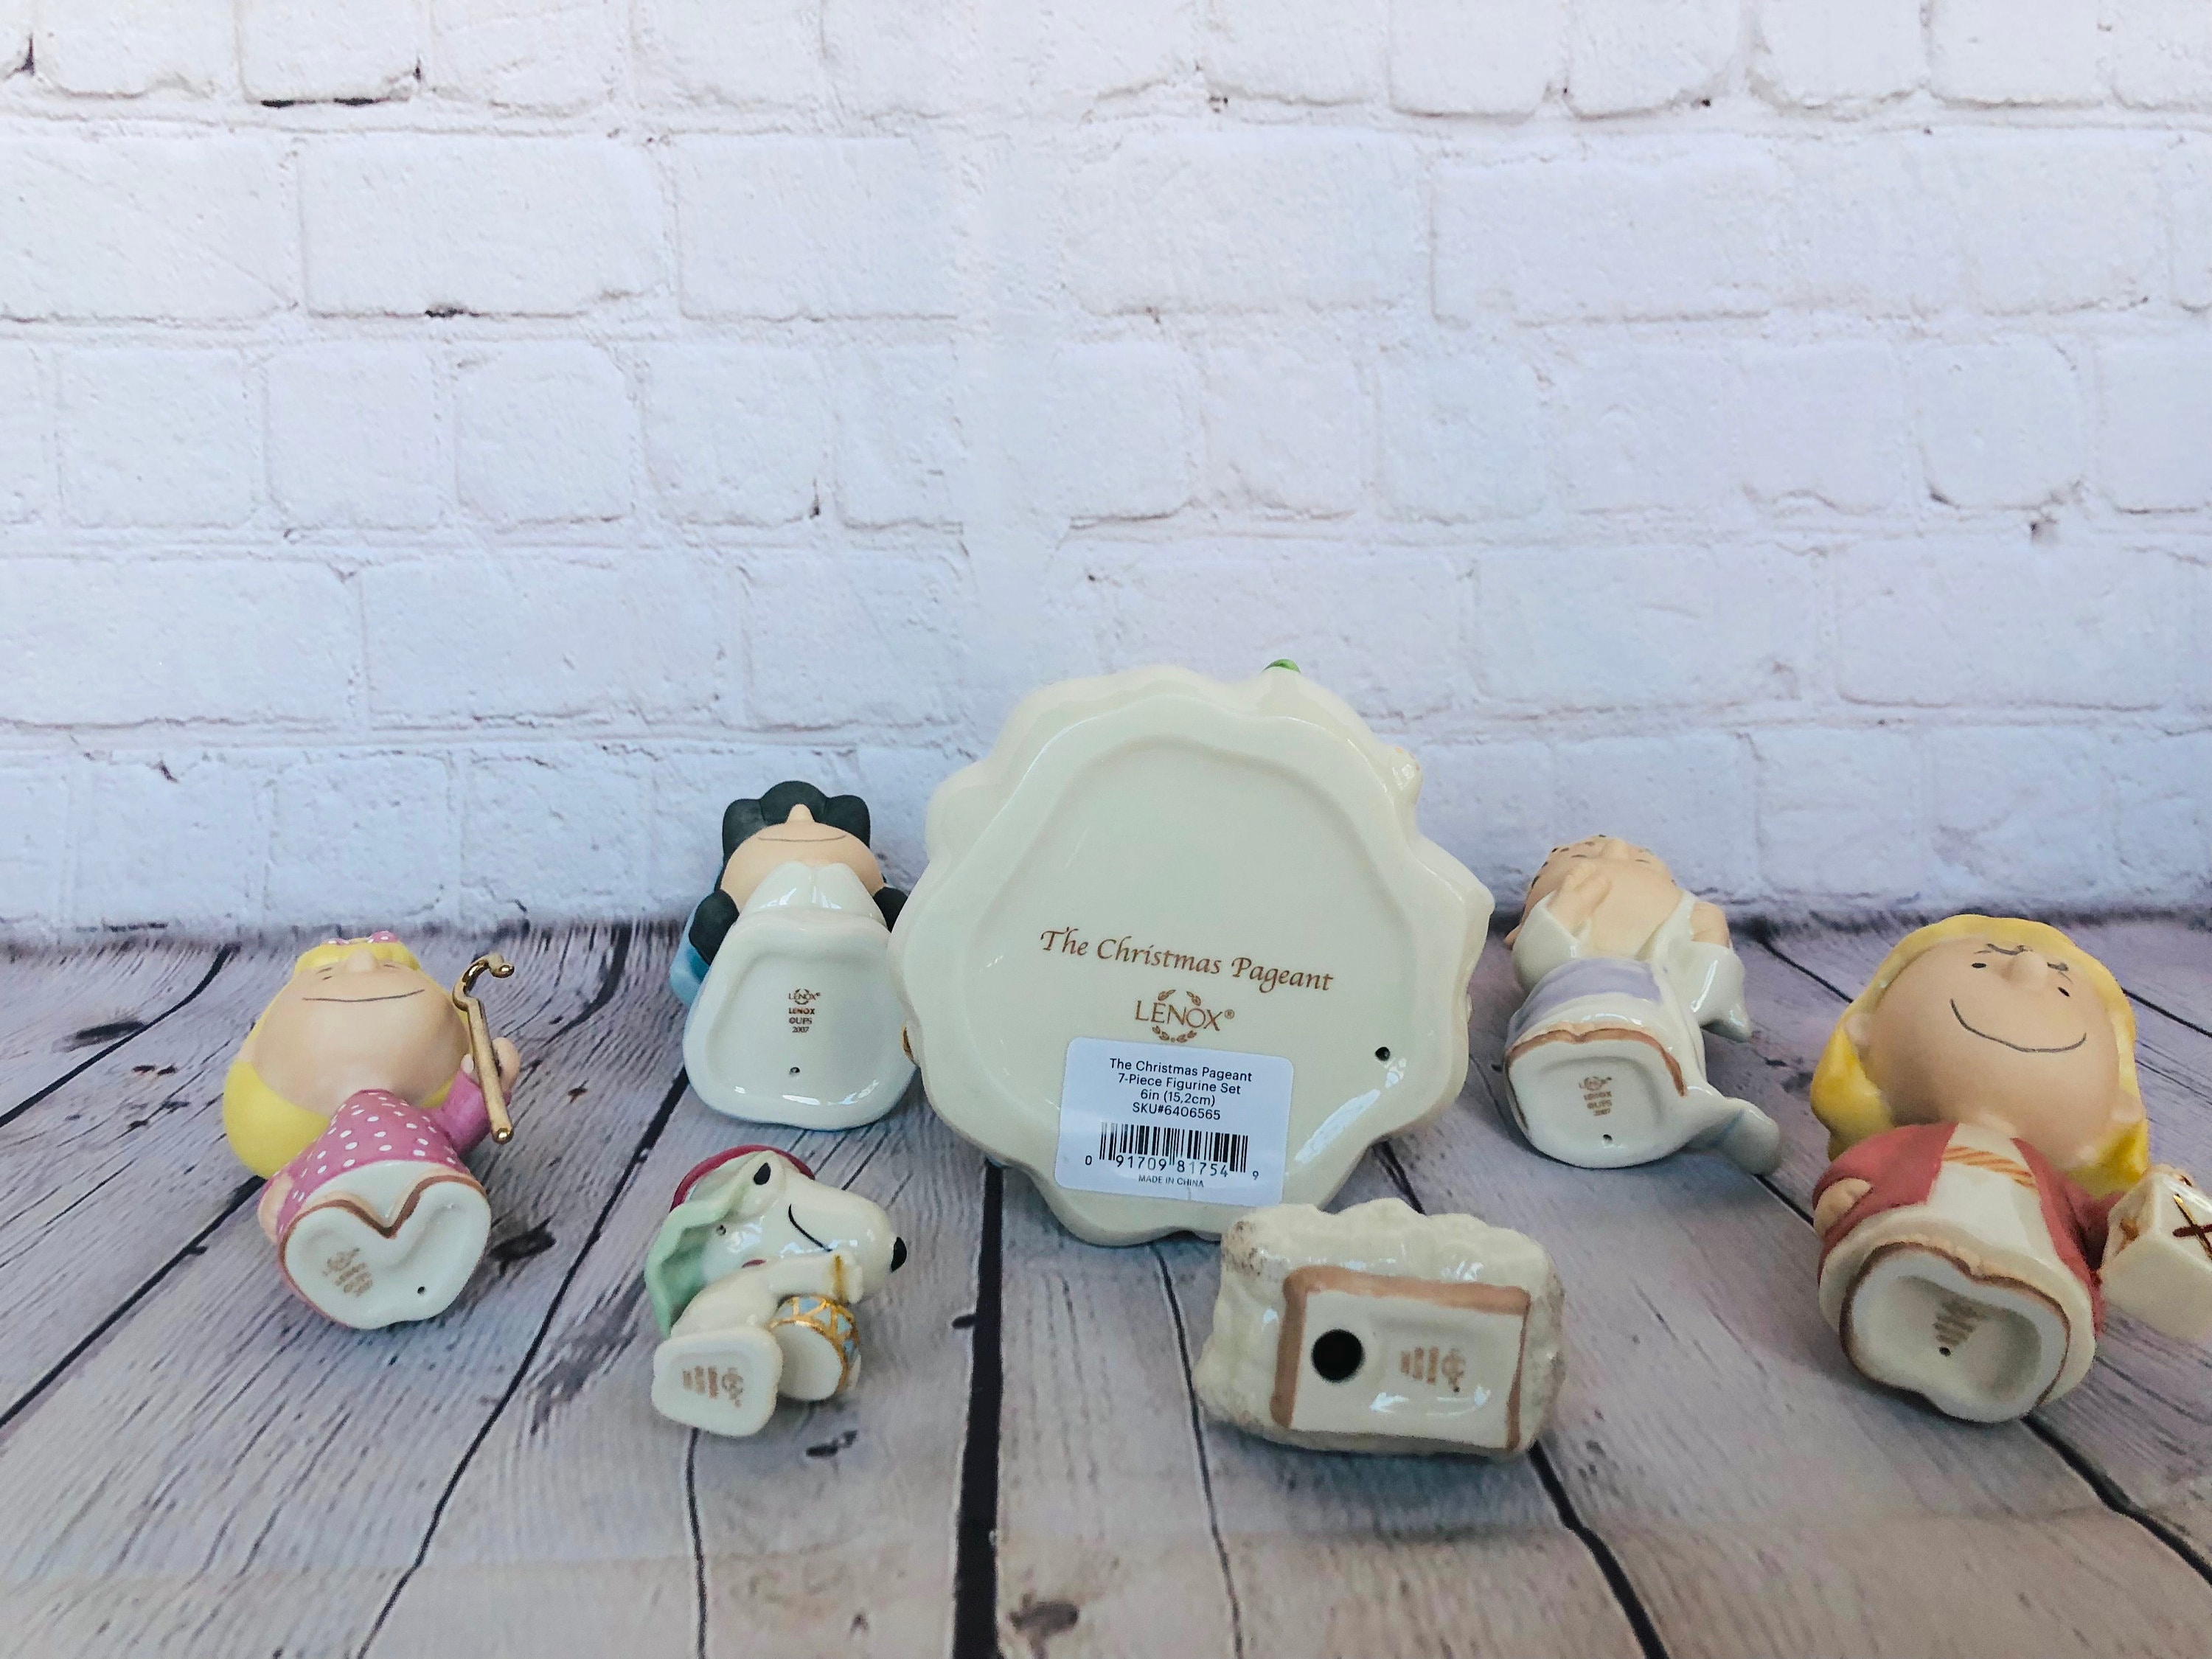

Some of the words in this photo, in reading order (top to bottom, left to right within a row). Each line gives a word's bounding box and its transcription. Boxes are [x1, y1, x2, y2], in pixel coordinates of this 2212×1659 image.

[1040, 927, 1089, 956] The
[1096, 936, 1222, 974] Christmas
[1231, 957, 1334, 993] Pageant
[1110, 1058, 1132, 1070] The
[1136, 1060, 1197, 1077] Christmas
[1202, 1066, 1252, 1082] Pageant
[1118, 1073, 1162, 1087] 7-Piece
[1166, 1077, 1217, 1091] Figurine
[1220, 1082, 1241, 1094] Set
[1141, 1088, 1159, 1100] 6in
[1132, 1102, 1221, 1120] SKU#6406565
[1085, 1155, 1092, 1166] 0
[1116, 1155, 1167, 1171] 91709
[1176, 1160, 1228, 1178] 81754
[1252, 1170, 1259, 1180] 9
[1138, 1174, 1163, 1184] MADE
[1165, 1176, 1175, 1184] IN
[1177, 1177, 1204, 1187] CHINA
